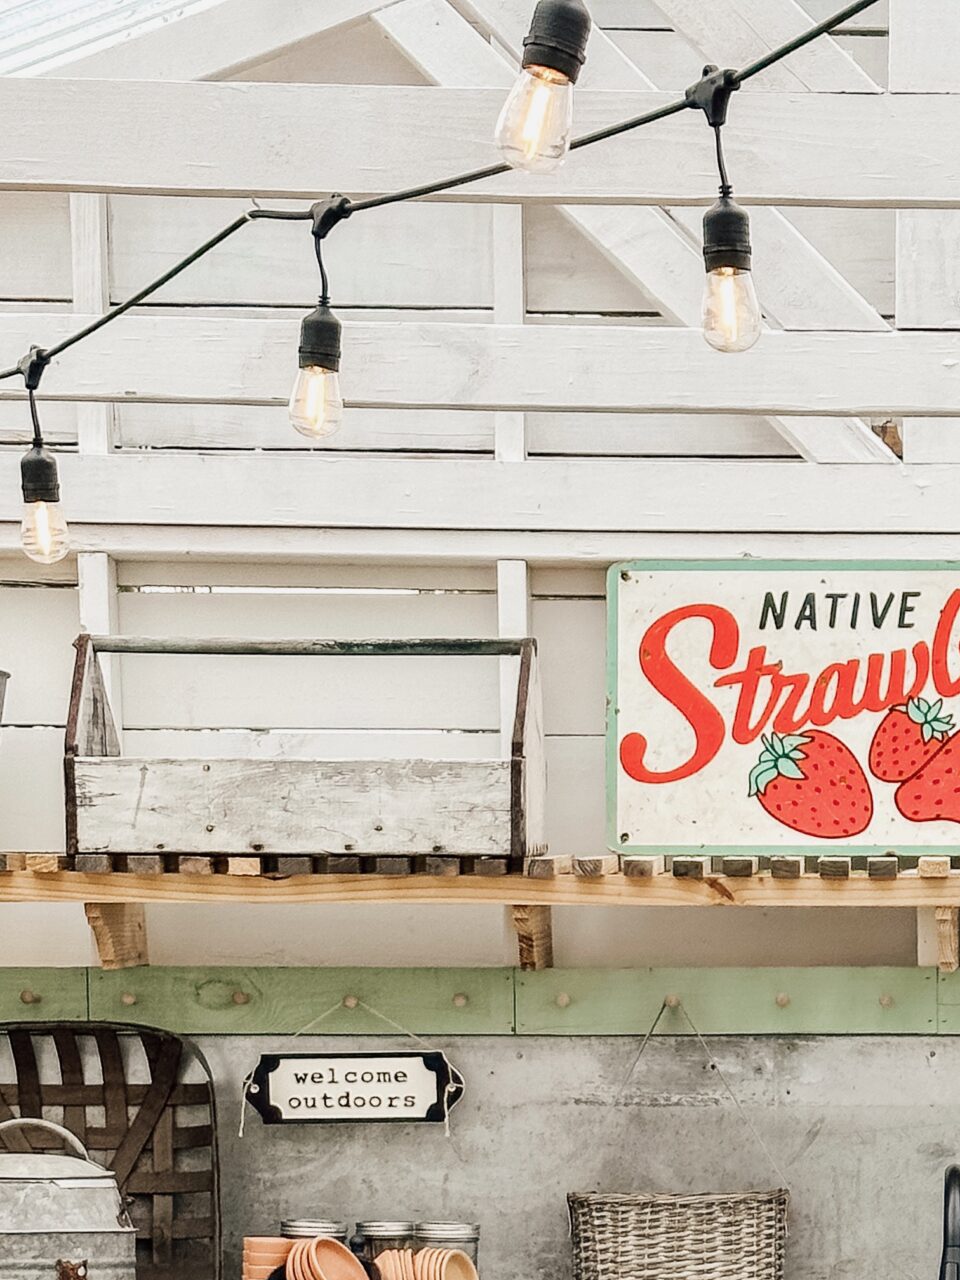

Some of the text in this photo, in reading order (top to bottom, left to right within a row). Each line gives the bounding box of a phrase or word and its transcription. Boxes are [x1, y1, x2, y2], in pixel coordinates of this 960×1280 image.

[758, 591, 921, 631] NATIVE
[293, 1067, 408, 1084] welcome
[288, 1091, 416, 1110] outdoors
